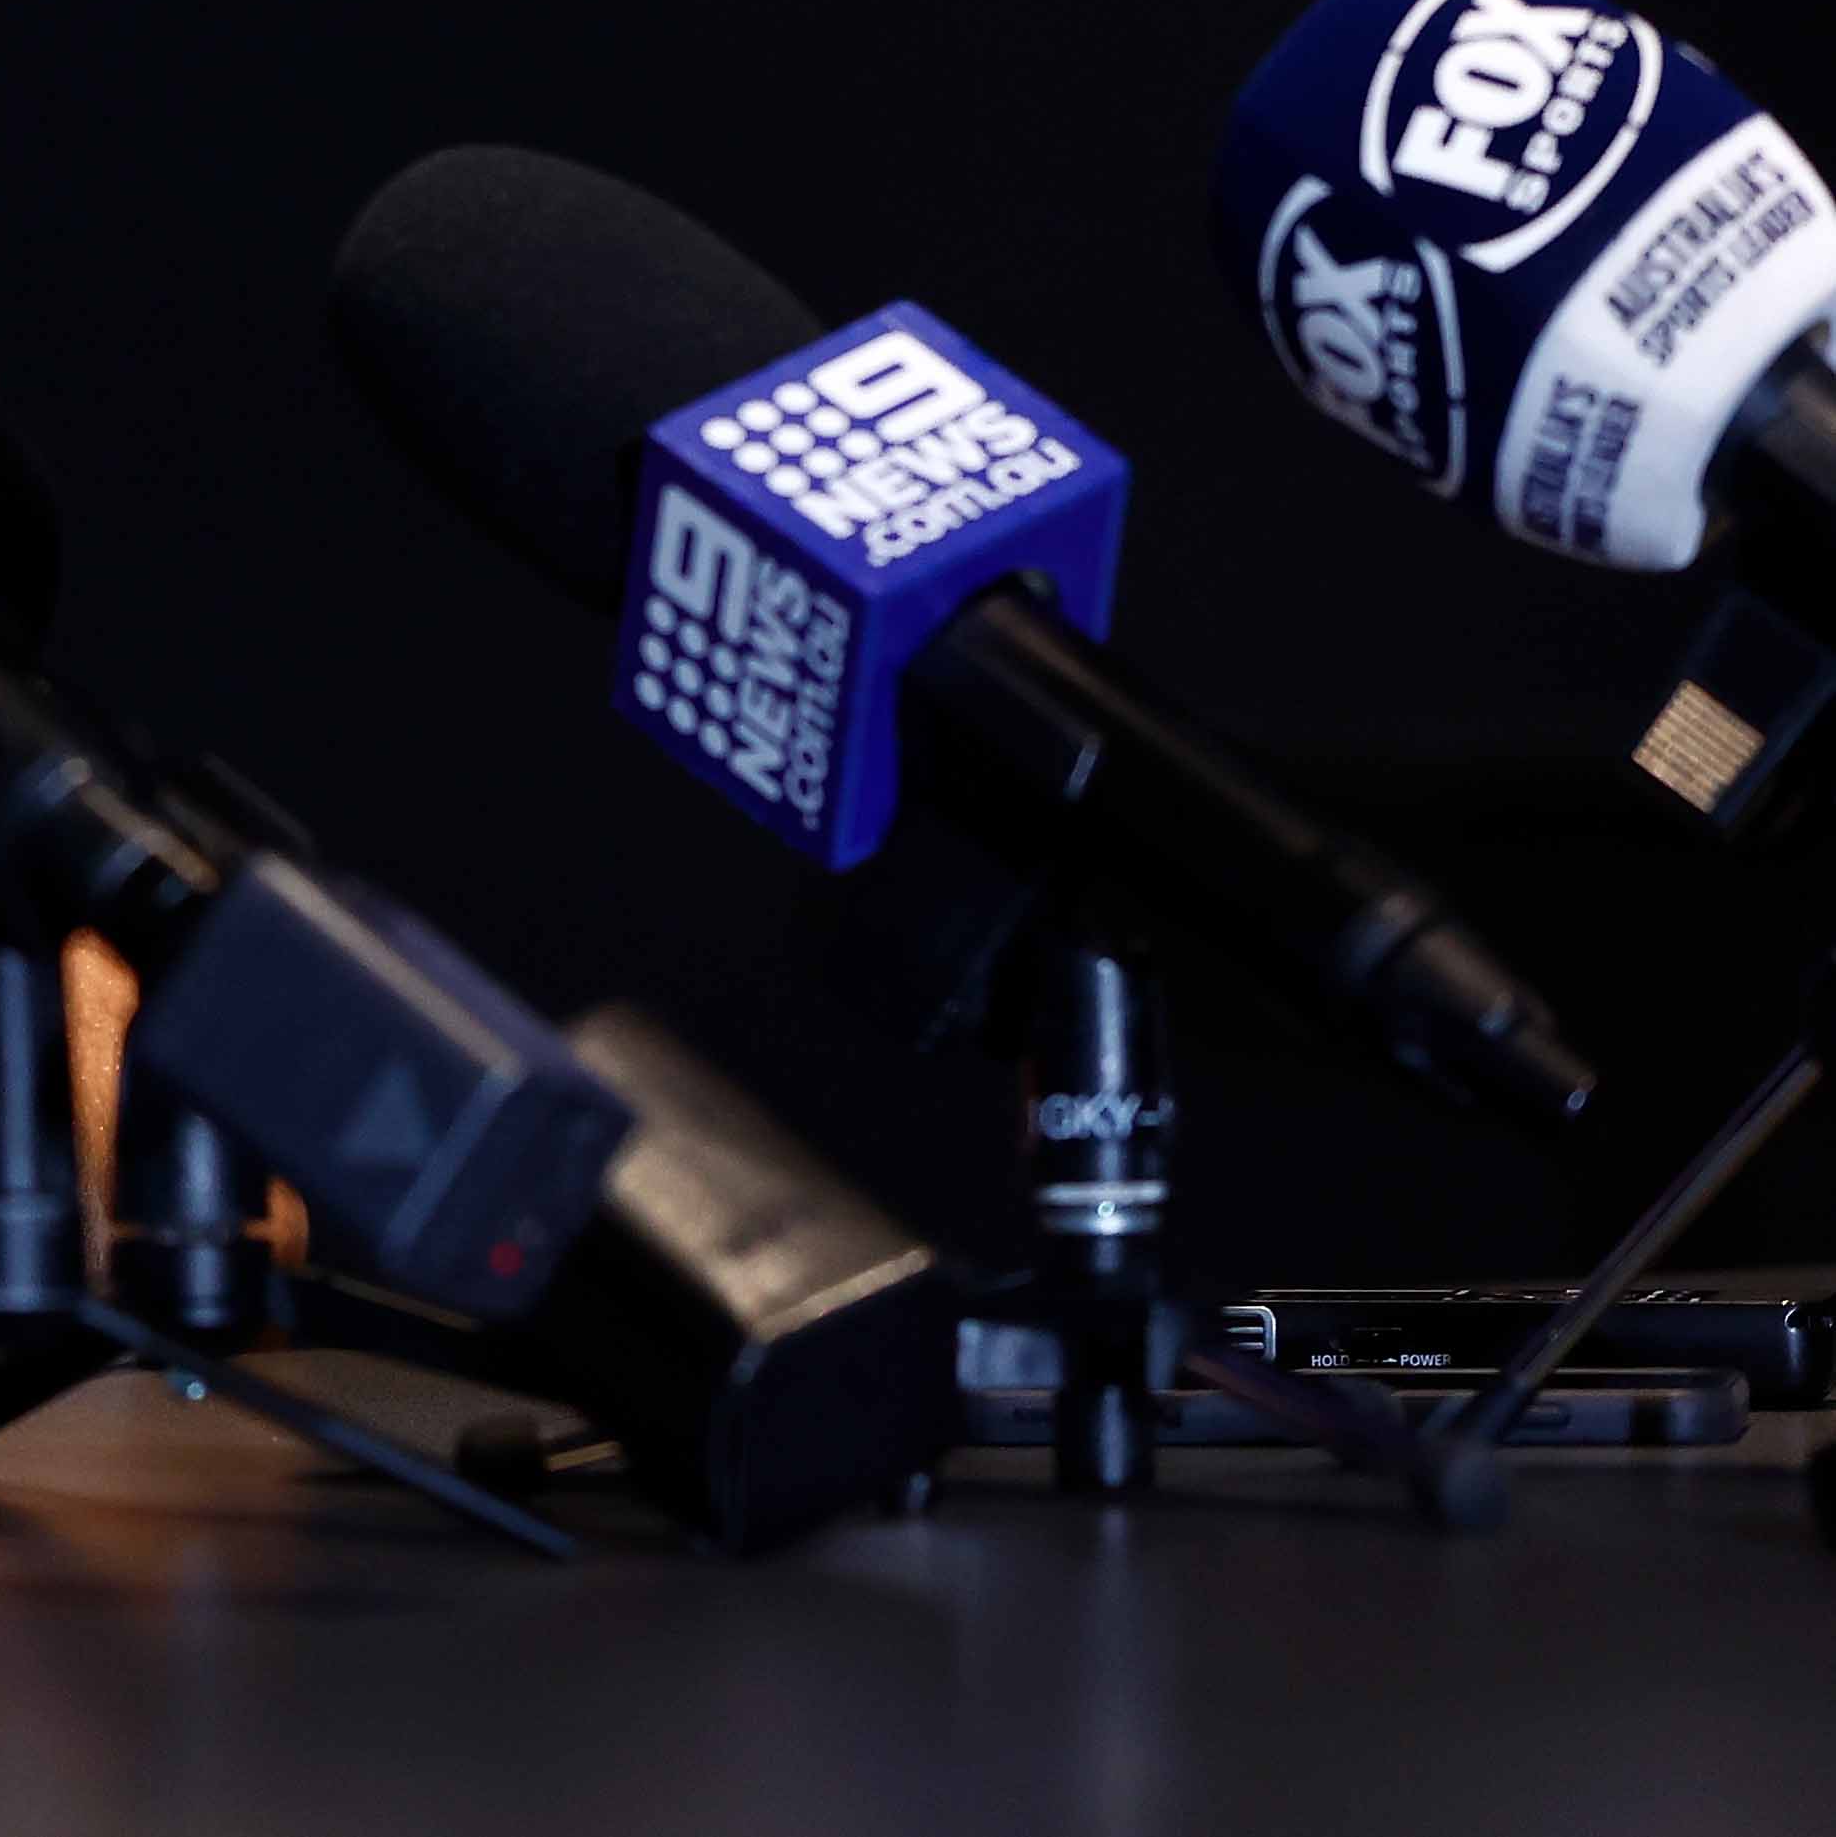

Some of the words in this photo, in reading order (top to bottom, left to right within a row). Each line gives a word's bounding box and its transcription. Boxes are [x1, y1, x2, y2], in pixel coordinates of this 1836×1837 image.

[1504, 13, 1629, 216] SPORTS
[790, 400, 1038, 540] NEWS
[729, 556, 811, 803] NEWS
[1311, 1354, 1350, 1367] HOLD
[1400, 1353, 1452, 1367] POWER
